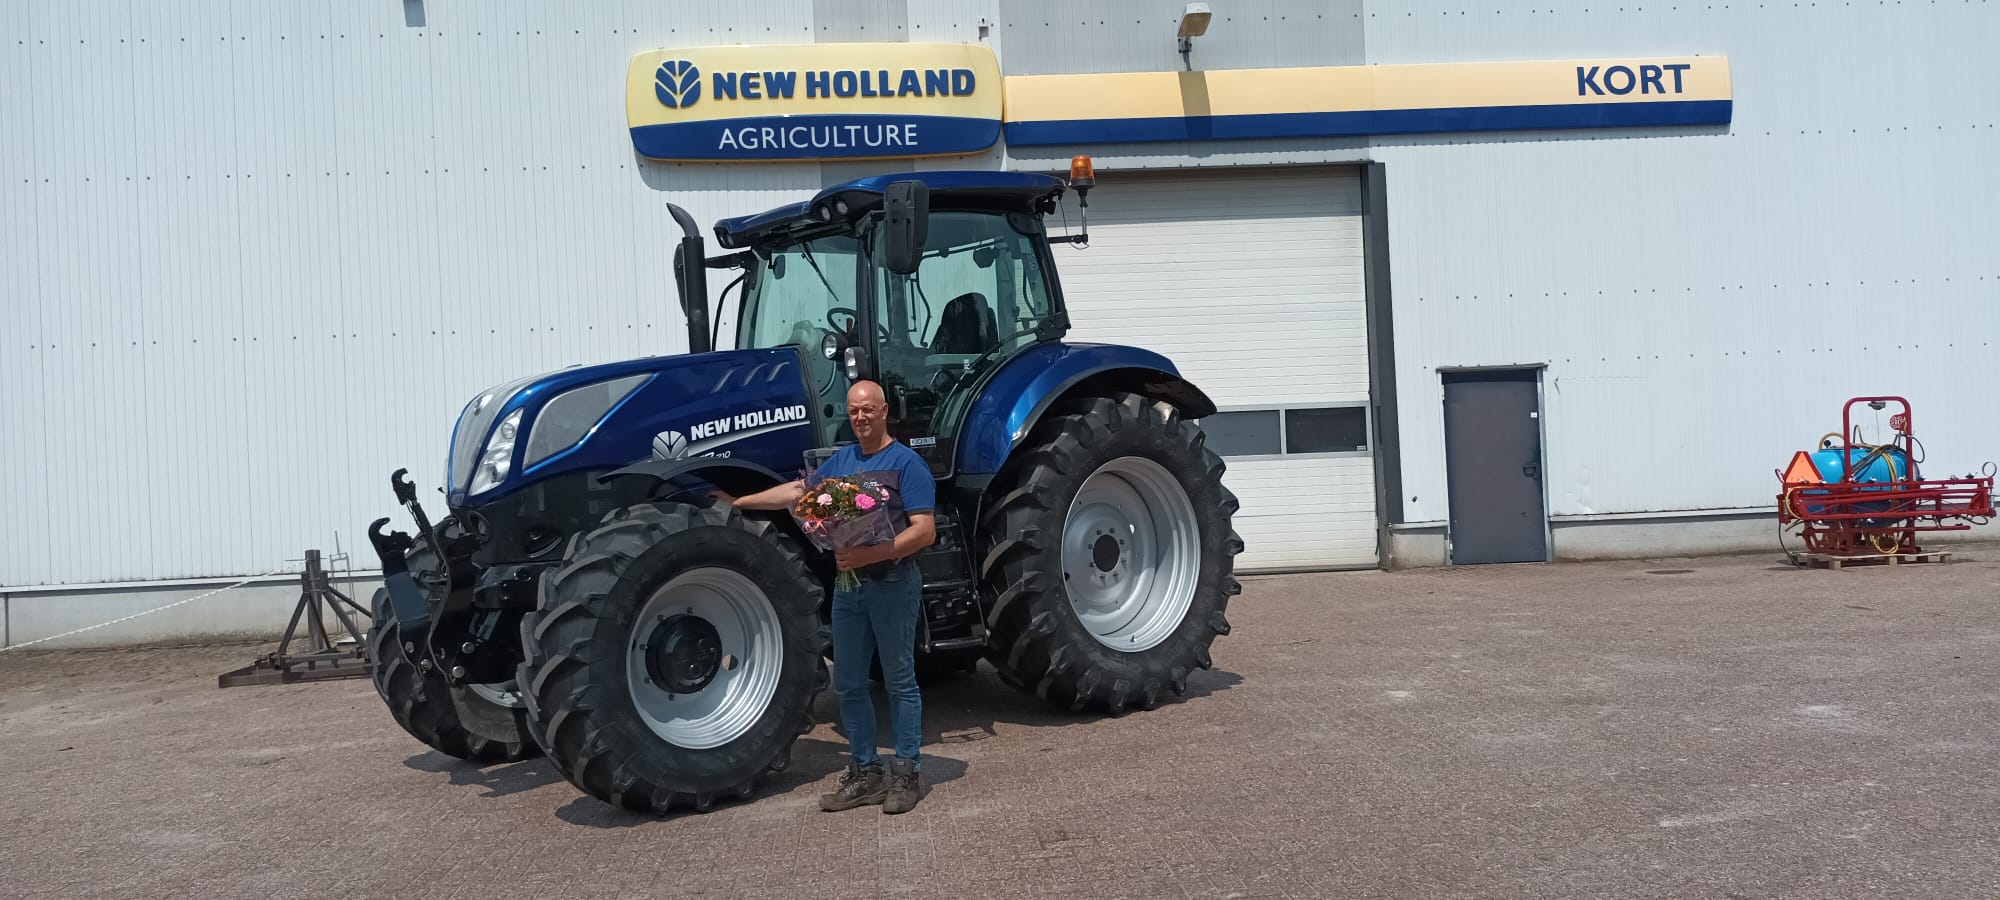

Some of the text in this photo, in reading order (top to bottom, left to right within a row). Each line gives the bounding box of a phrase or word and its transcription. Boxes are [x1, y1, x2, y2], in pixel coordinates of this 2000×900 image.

[712, 68, 976, 100] NEW HOLLAND
[1576, 64, 1691, 96] KORT
[718, 124, 919, 150] AGRICULTURE
[690, 404, 807, 441] NEW HOLLAND
